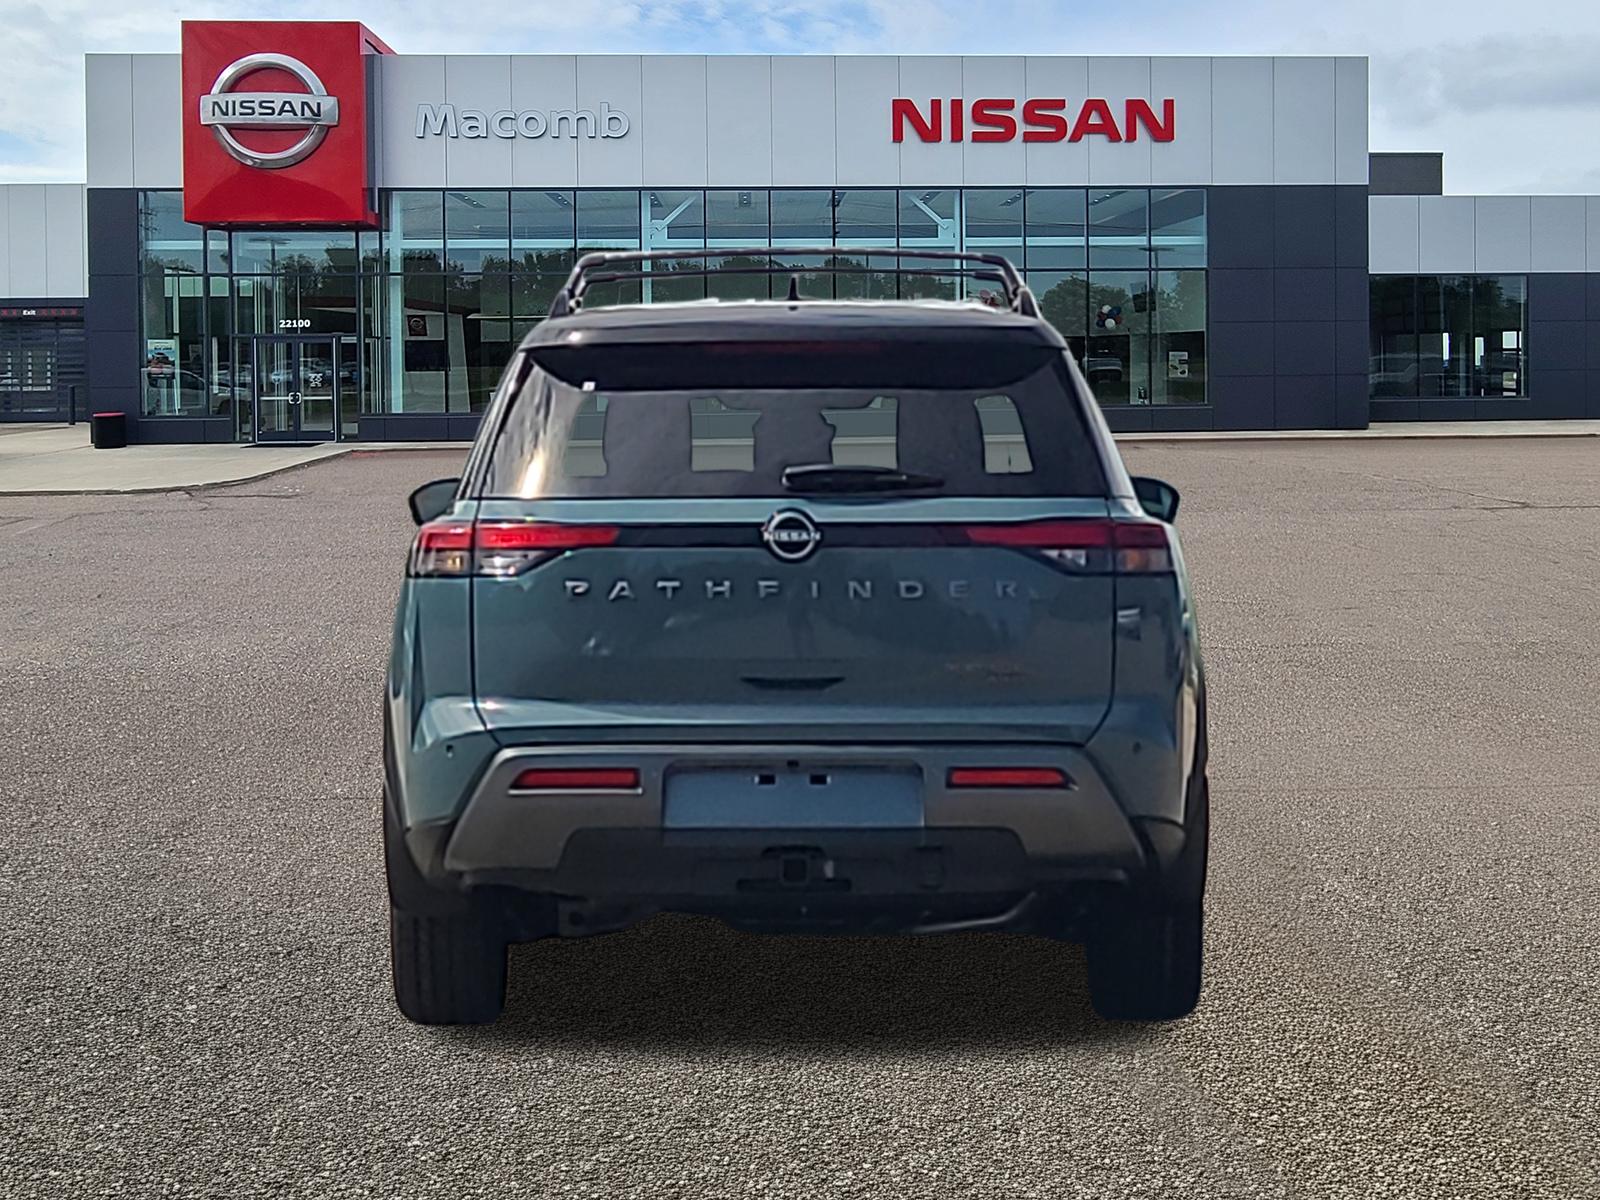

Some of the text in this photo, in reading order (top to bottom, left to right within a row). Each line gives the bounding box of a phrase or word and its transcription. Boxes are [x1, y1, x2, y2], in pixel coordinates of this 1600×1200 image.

[211, 100, 322, 117] NISSAN
[415, 101, 630, 139] Macomb
[892, 98, 1175, 143] NISSAN
[279, 319, 311, 328] 22100
[564, 579, 1018, 600] PATHFINDER
